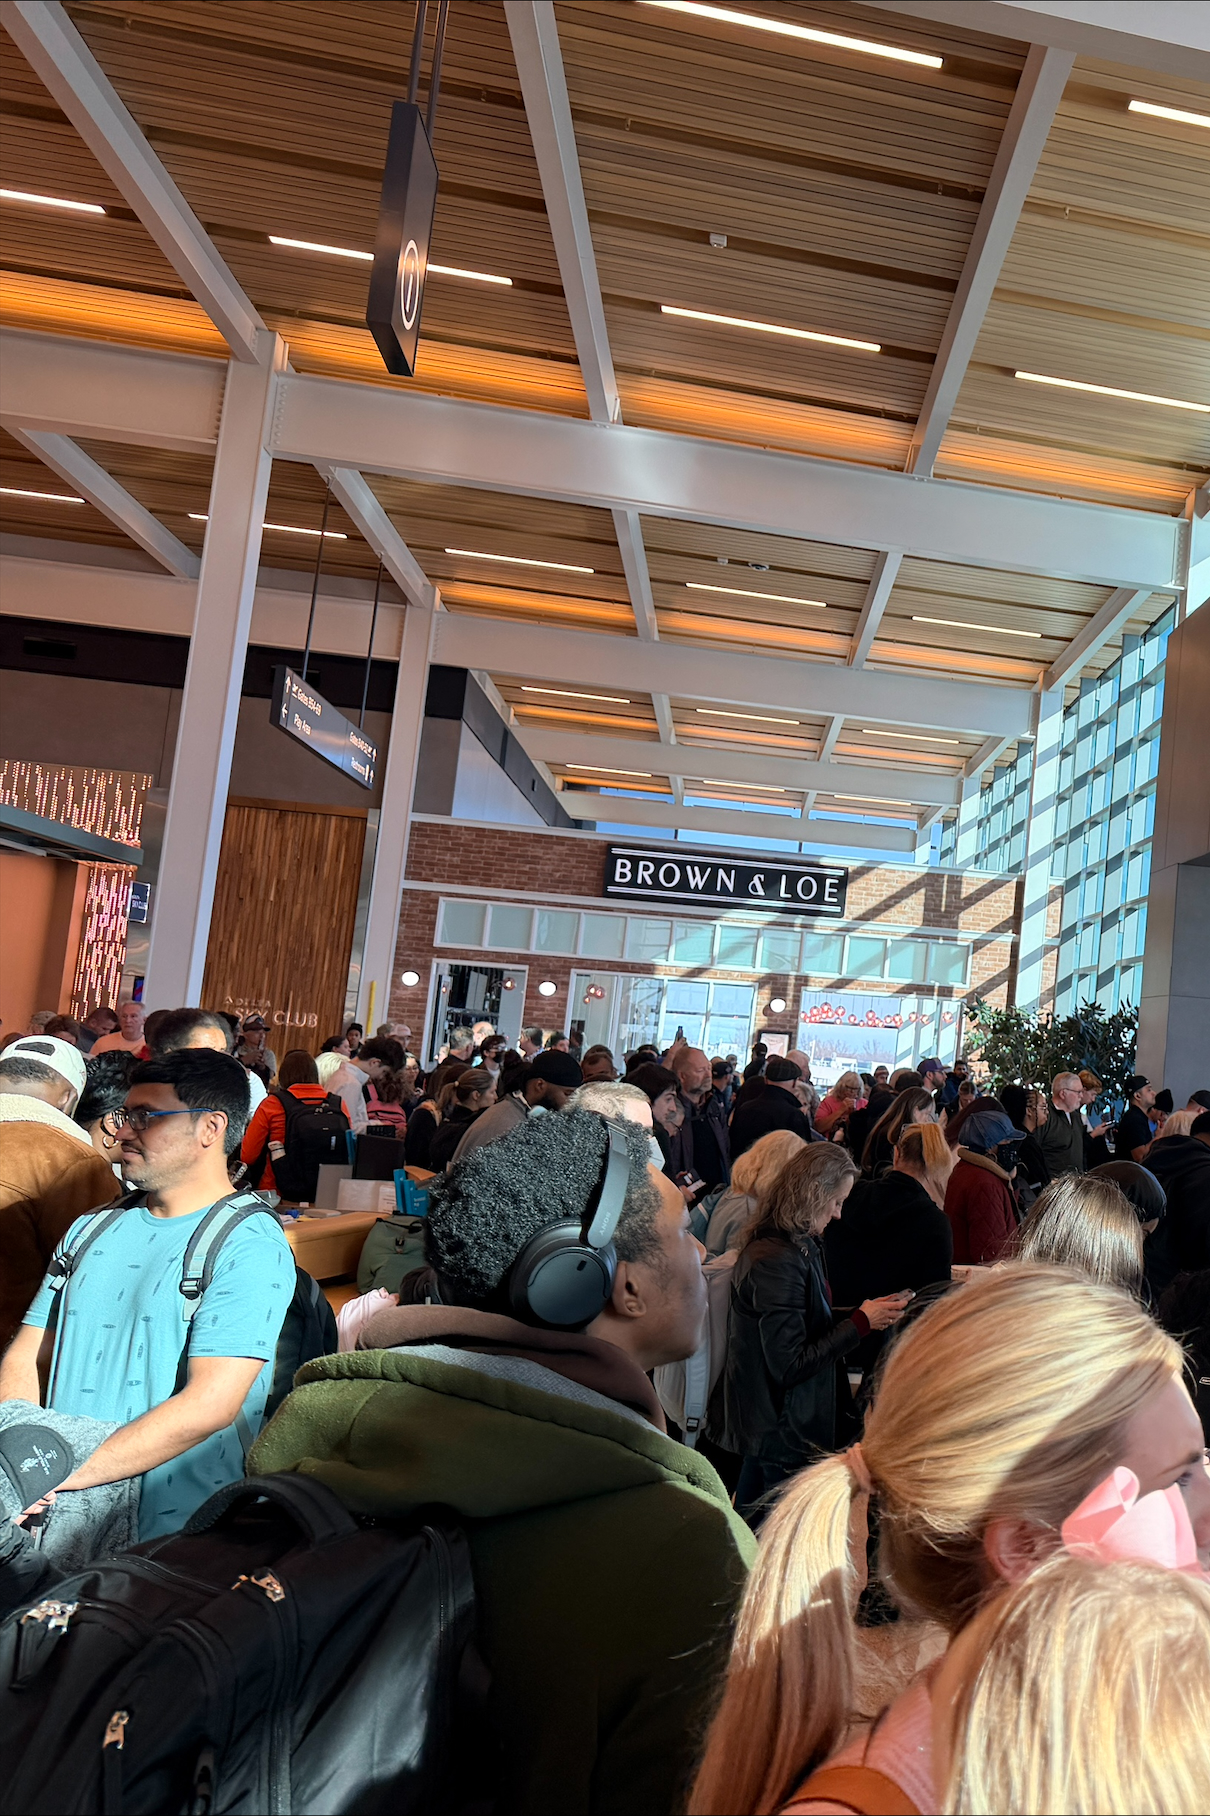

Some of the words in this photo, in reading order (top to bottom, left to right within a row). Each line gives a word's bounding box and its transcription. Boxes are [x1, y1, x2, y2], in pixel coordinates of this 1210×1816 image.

[298, 688, 309, 706] Gates
[294, 713, 303, 731] Play
[302, 720, 311, 736] Area
[613, 858, 736, 893] BROWN
[748, 873, 766, 896] &
[780, 874, 840, 903] LOE
[273, 1010, 318, 1028] CLUB
[599, 1211, 612, 1236] SONY
